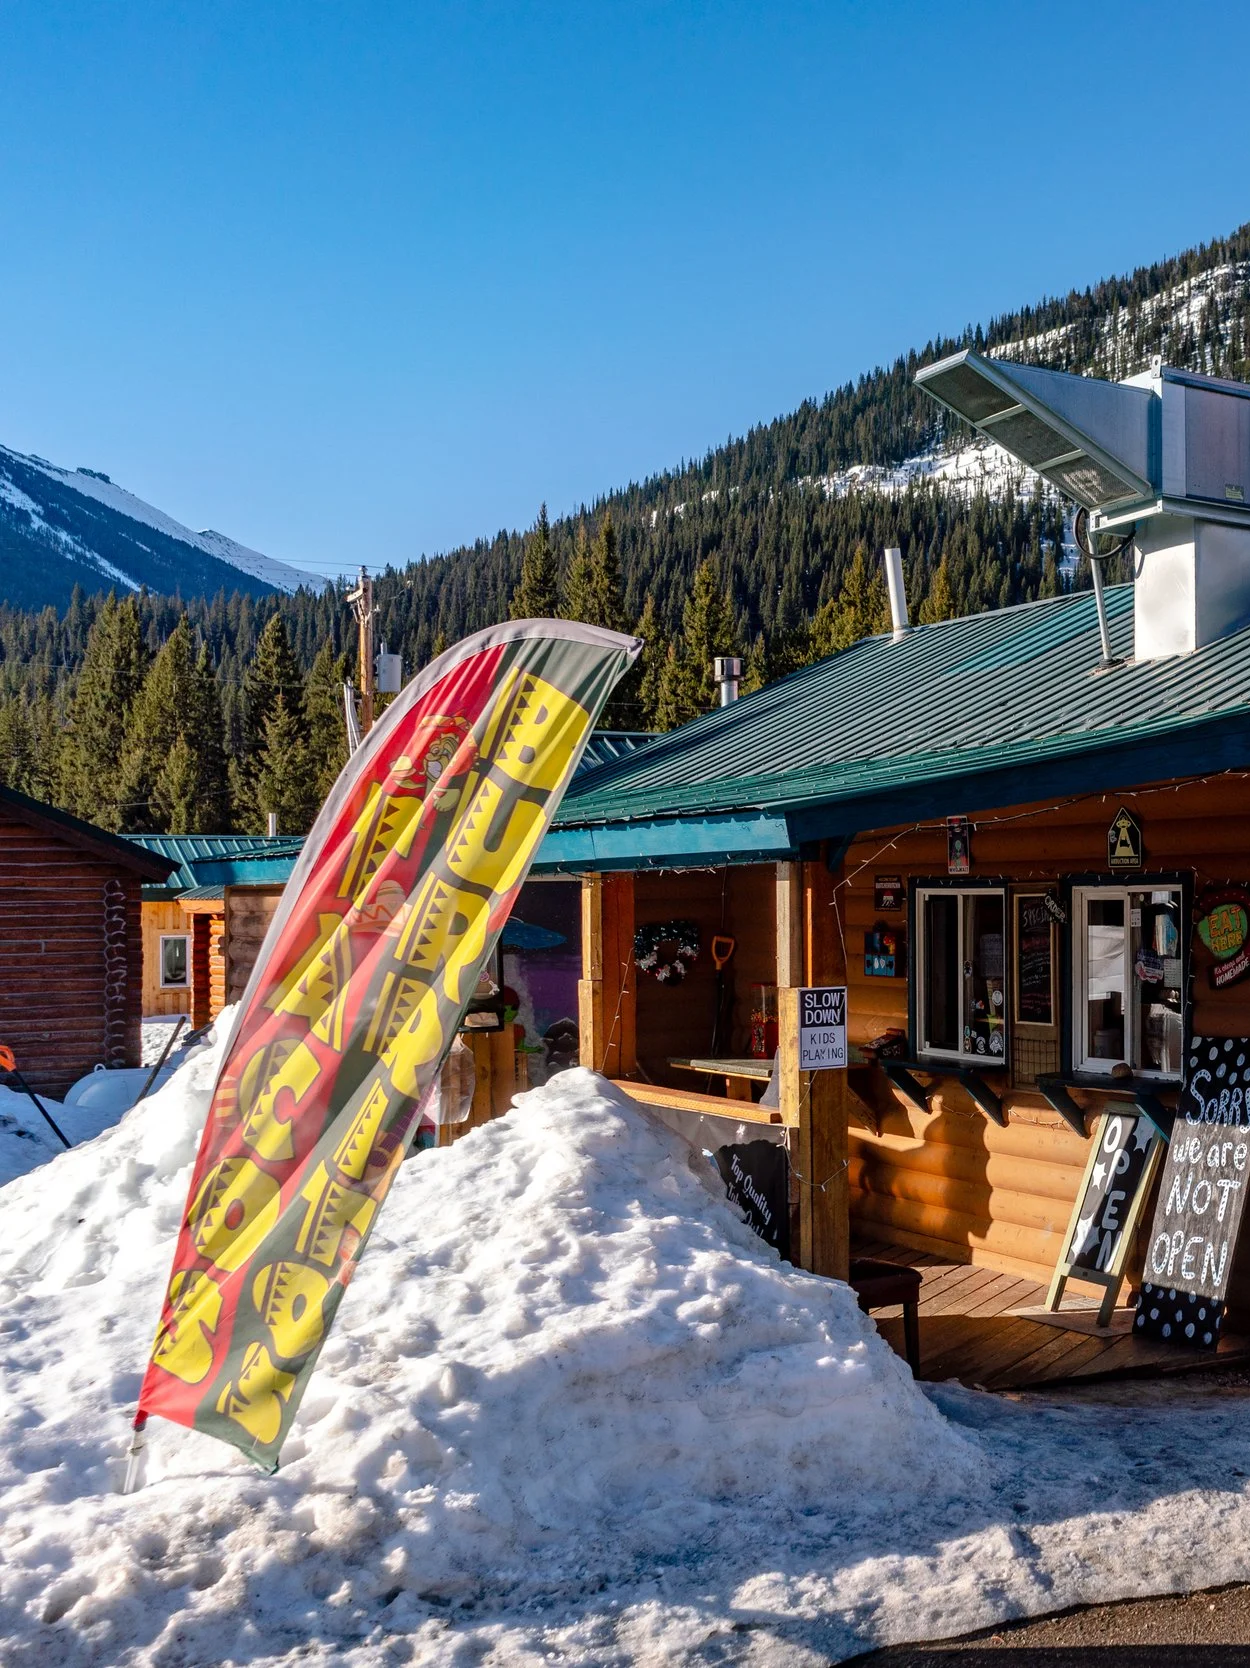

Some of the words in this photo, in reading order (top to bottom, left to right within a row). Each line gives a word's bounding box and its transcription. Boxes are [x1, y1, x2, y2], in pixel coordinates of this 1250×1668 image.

[1208, 905, 1243, 938] EAT
[804, 992, 840, 1008] SLOW
[804, 1008, 841, 1025] DOWN
[216, 665, 590, 1444] BURRITOS
[803, 1047, 844, 1061] PLAYING
[810, 1032, 836, 1045] KIDS
[151, 781, 426, 1384] TACOS
[1172, 1136, 1203, 1164] we
[1206, 1141, 1248, 1171] are
[731, 1153, 744, 1184] Top
[742, 1174, 772, 1226] Quality
[1095, 1115, 1131, 1274] OPEN
[1165, 1170, 1242, 1223] NOT
[1151, 1230, 1229, 1287] OPEN
